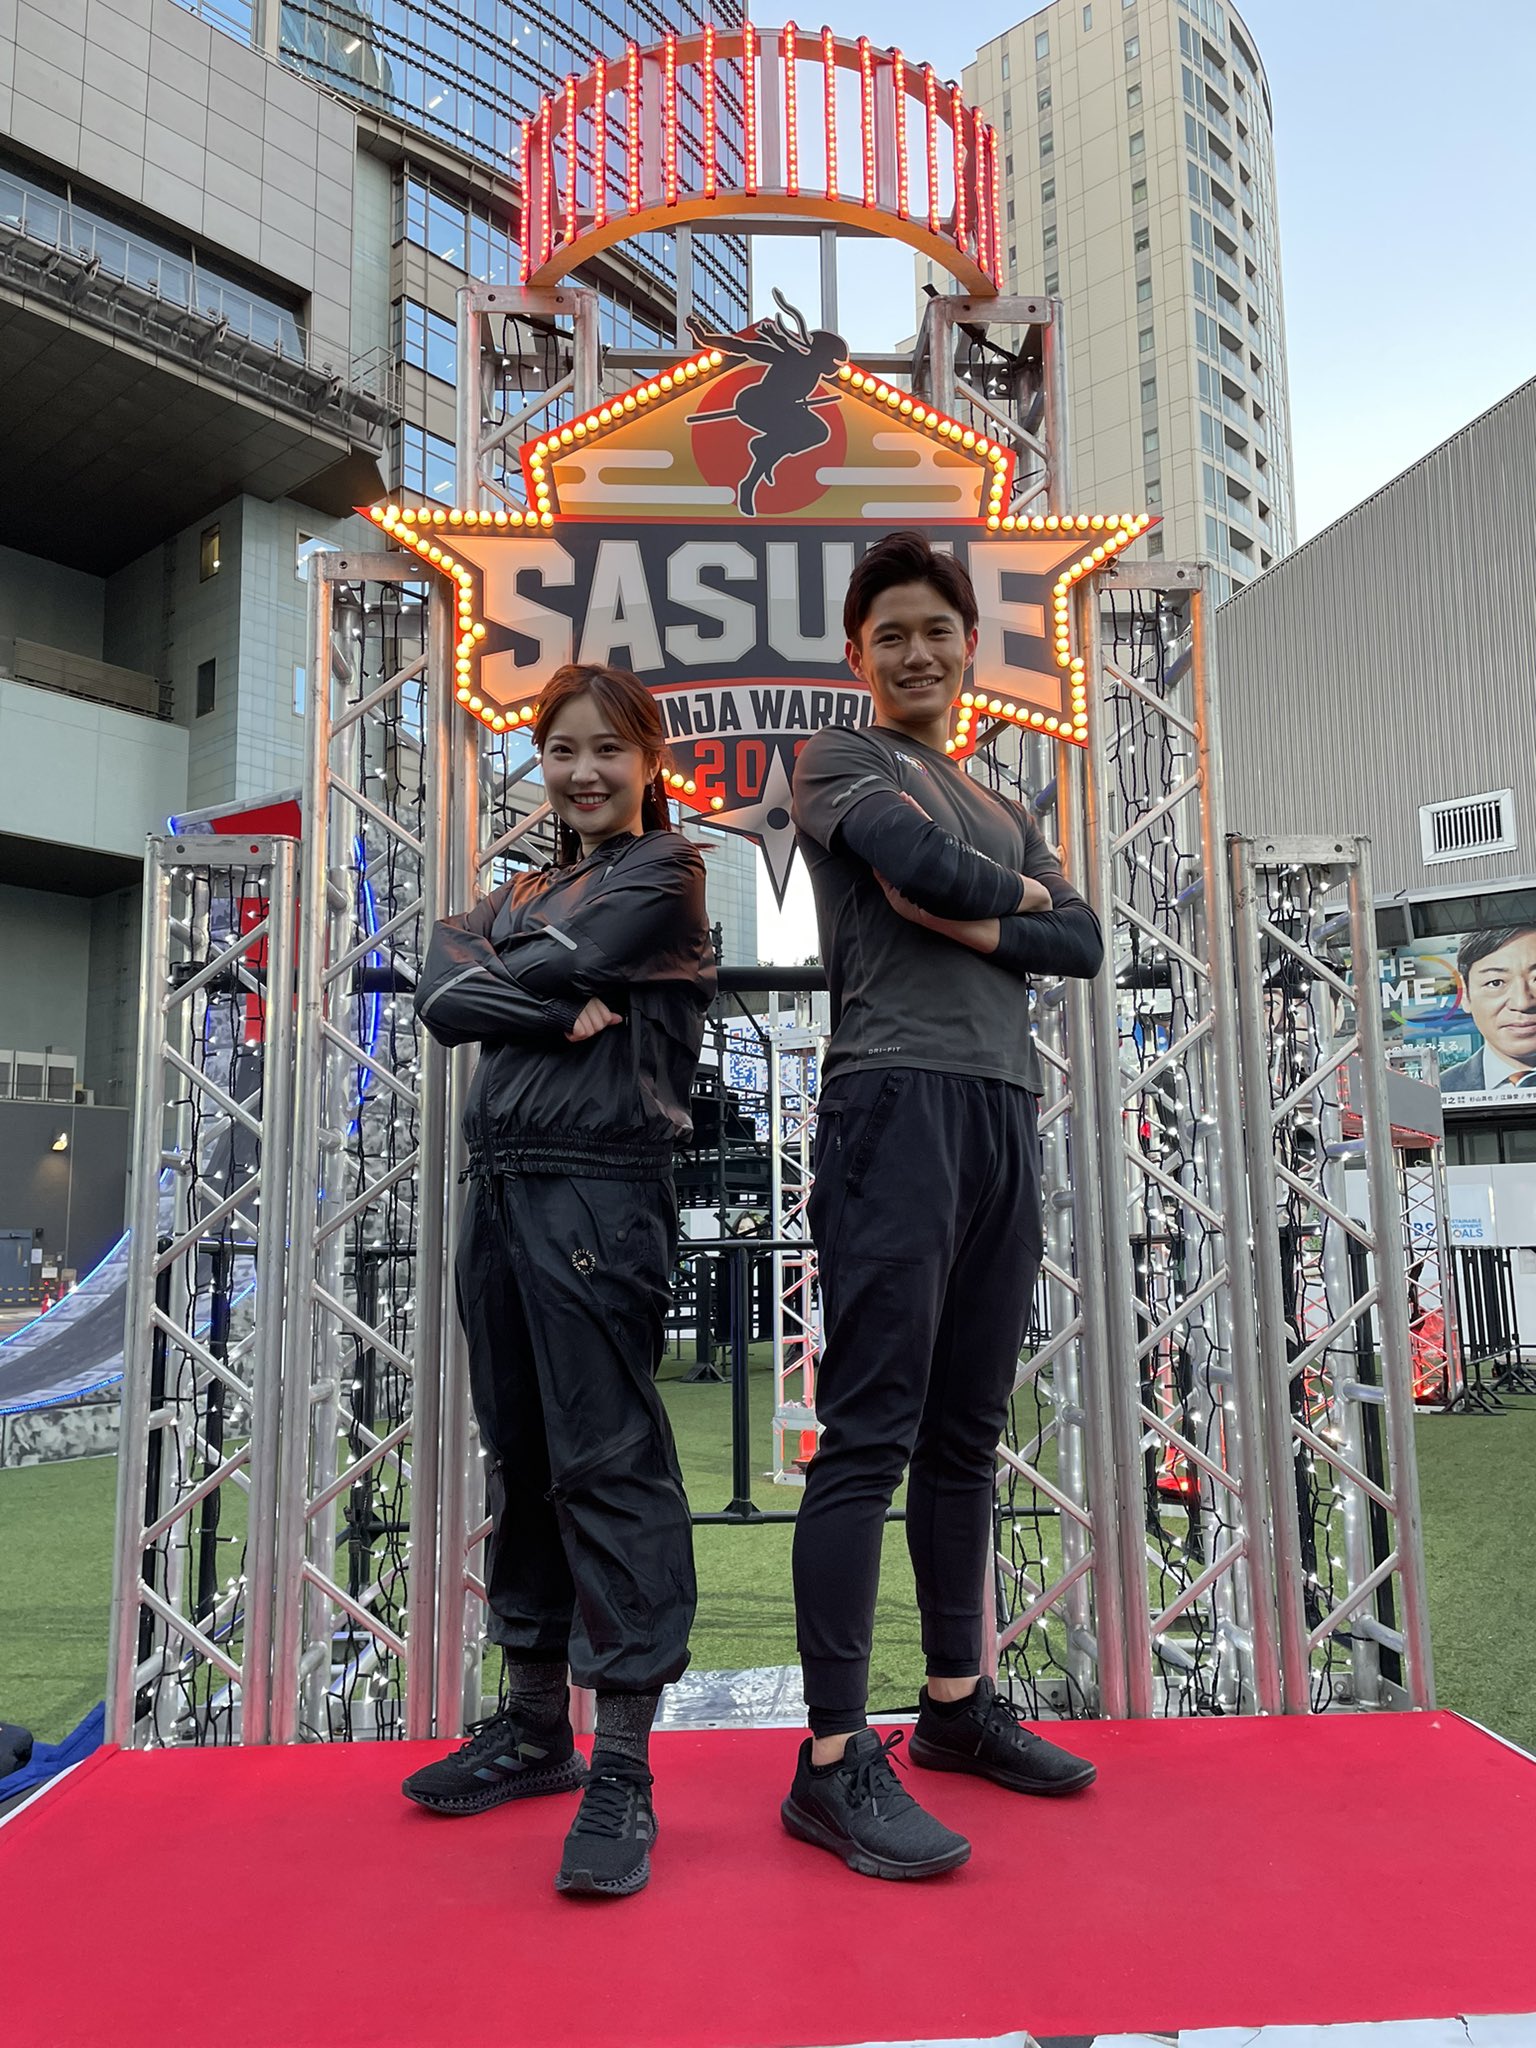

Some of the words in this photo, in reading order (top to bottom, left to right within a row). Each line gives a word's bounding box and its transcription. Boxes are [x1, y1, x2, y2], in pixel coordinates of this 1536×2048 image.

[434, 534, 1091, 712] SASUE
[655, 691, 742, 738] INJA
[749, 690, 876, 731] WARRI
[694, 740, 808, 797] 20
[1379, 956, 1416, 978] HE
[1381, 977, 1449, 1009] ME,
[868, 1046, 902, 1055] DRI-FIT
[1453, 1229, 1484, 1238] OALS
